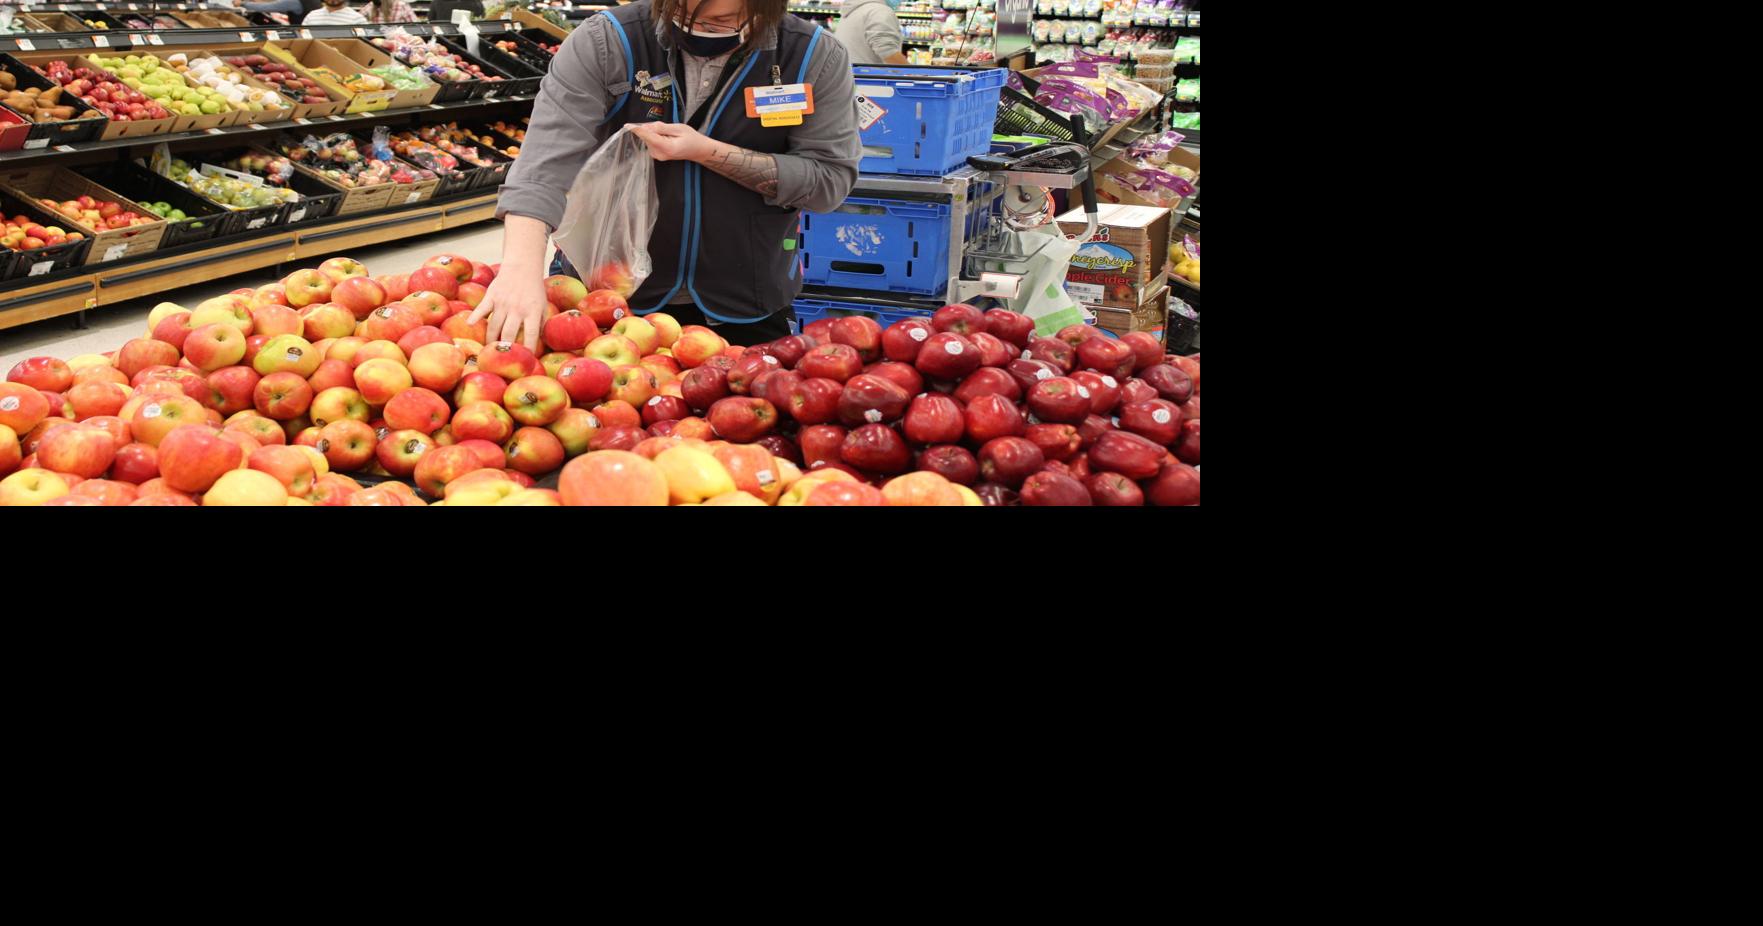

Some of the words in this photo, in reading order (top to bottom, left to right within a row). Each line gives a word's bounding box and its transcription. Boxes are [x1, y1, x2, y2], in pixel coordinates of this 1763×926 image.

[634, 84, 663, 99] Walmart
[769, 95, 792, 104] MIKE
[1072, 256, 1136, 273] neycrisp
[1066, 271, 1091, 282] pple
[1095, 272, 1130, 285] Cider
